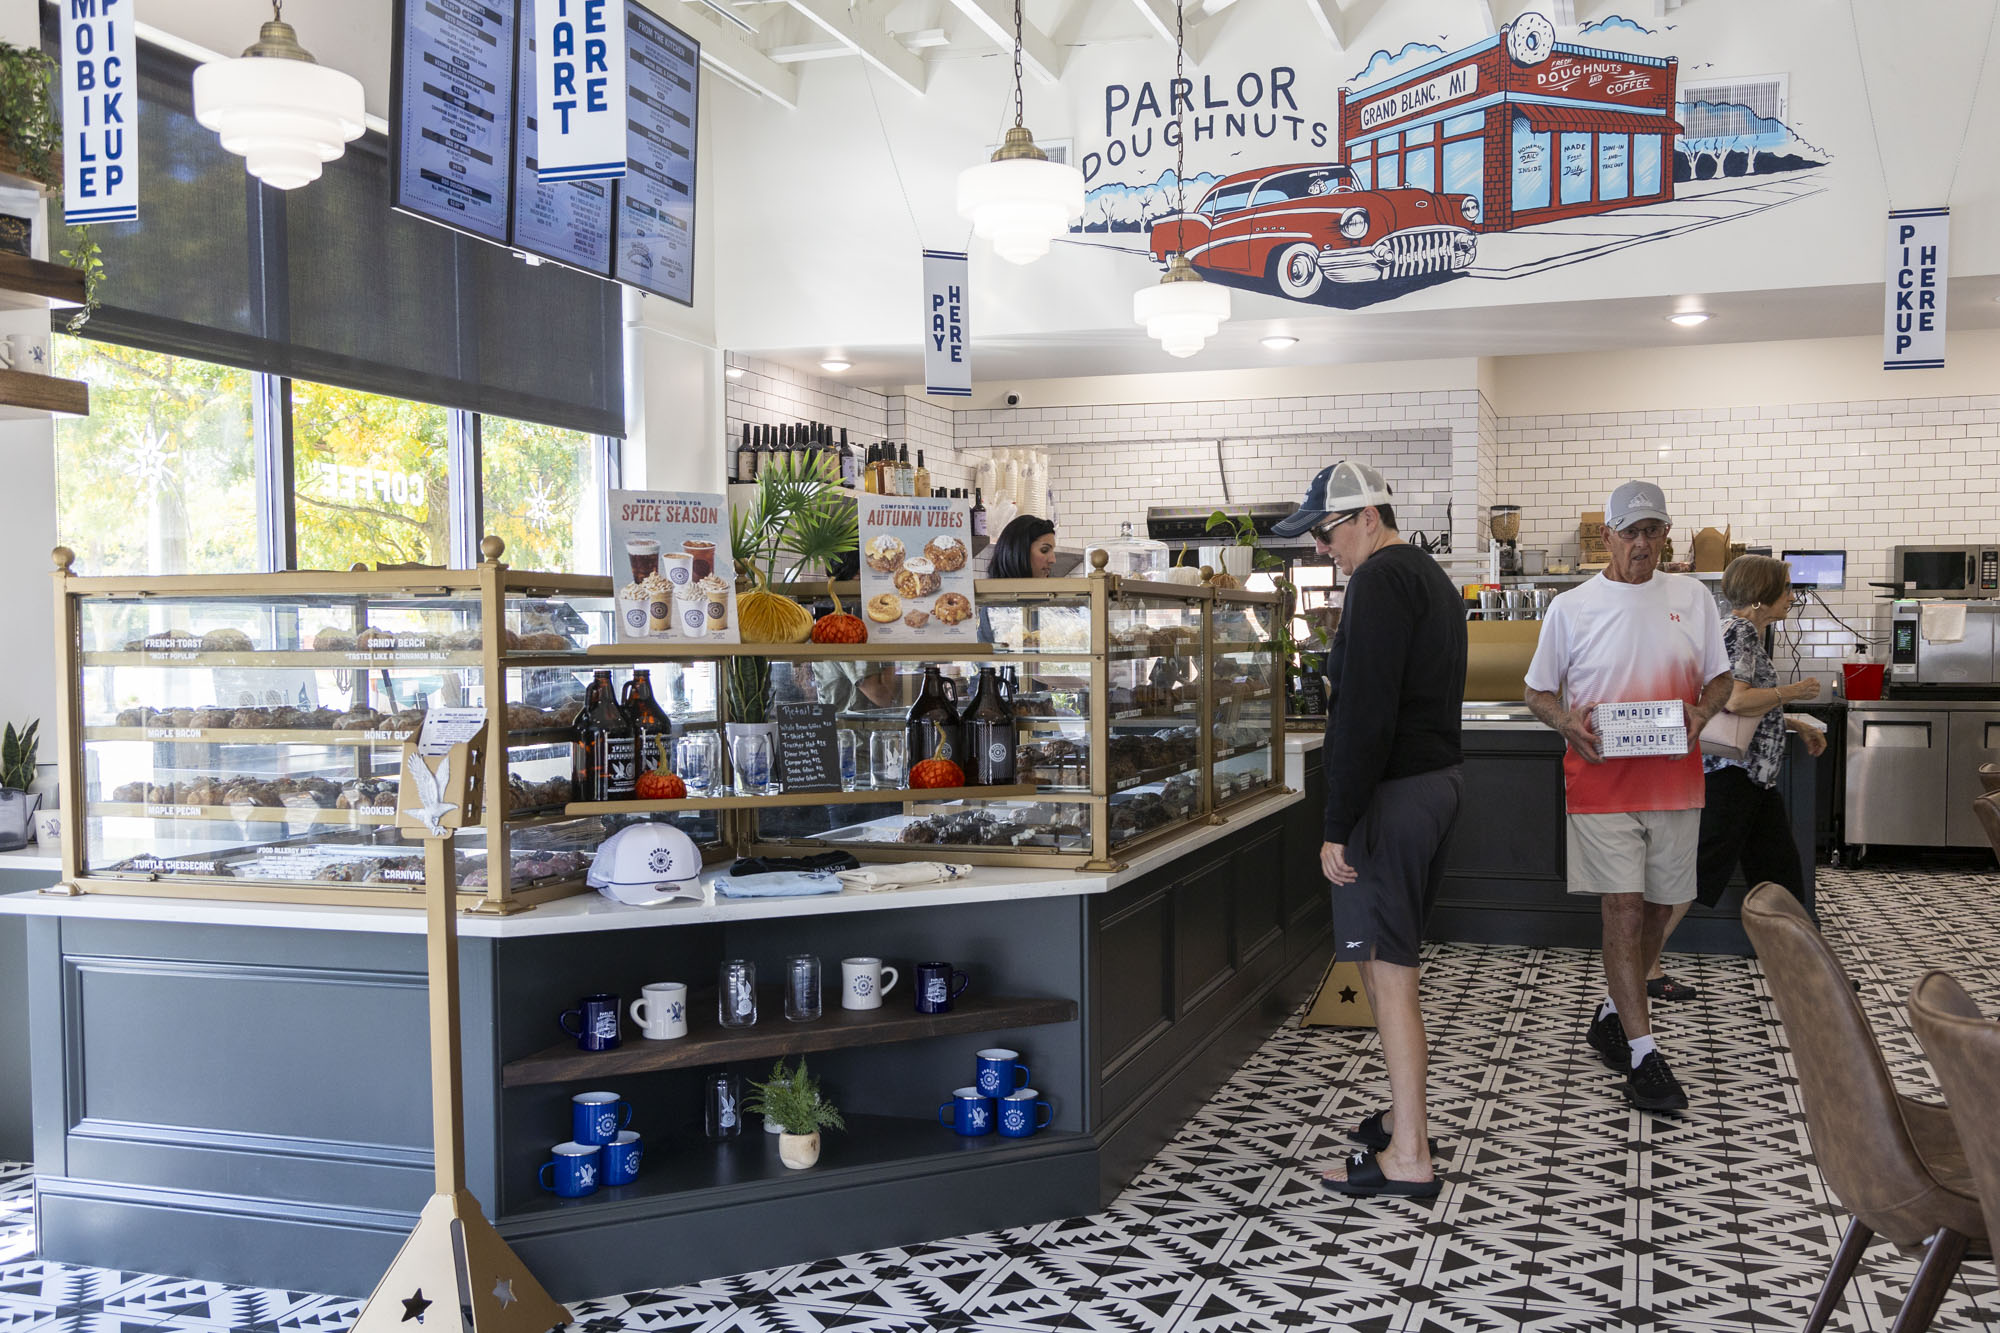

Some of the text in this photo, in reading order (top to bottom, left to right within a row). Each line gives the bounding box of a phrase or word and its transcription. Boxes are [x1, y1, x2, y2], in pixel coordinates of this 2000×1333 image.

[638, 21, 653, 38] FROM
[1551, 58, 1573, 67] FRESH
[1537, 63, 1622, 85] DOUGHNUTS
[1588, 75, 1603, 84] AND
[1606, 78, 1651, 94] COFFEE
[1105, 66, 1298, 137] PARLOR
[1363, 70, 1466, 126] GRAND BLANC, MI
[1082, 113, 1328, 183] DOUGHNUTS
[1564, 143, 1586, 152] MADE
[1896, 225, 1915, 354] PICKUP
[1919, 245, 1937, 332] HERE
[932, 294, 945, 351] PAY
[948, 285, 962, 363] HERE
[621, 503, 719, 525] SPICE SEASON
[867, 509, 964, 528] AUTUMN VIBES
[145, 638, 203, 648] FRENCH TOAST
[367, 638, 426, 648] SANDY BEACH
[373, 652, 388, 660] LIKE
[782, 704, 810, 720] Retail
[1617, 707, 1663, 717] MADE
[147, 728, 201, 738] MAPLE BACON
[364, 731, 392, 740] HONEY
[1622, 734, 1667, 744] MADE
[148, 806, 202, 816] MAPLE PECAN
[360, 806, 395, 816] COOKIES
[650, 848, 671, 857] PARLOR
[134, 859, 215, 871] TURTLE CHEESECAKE
[384, 869, 426, 880] CARNIVAL
